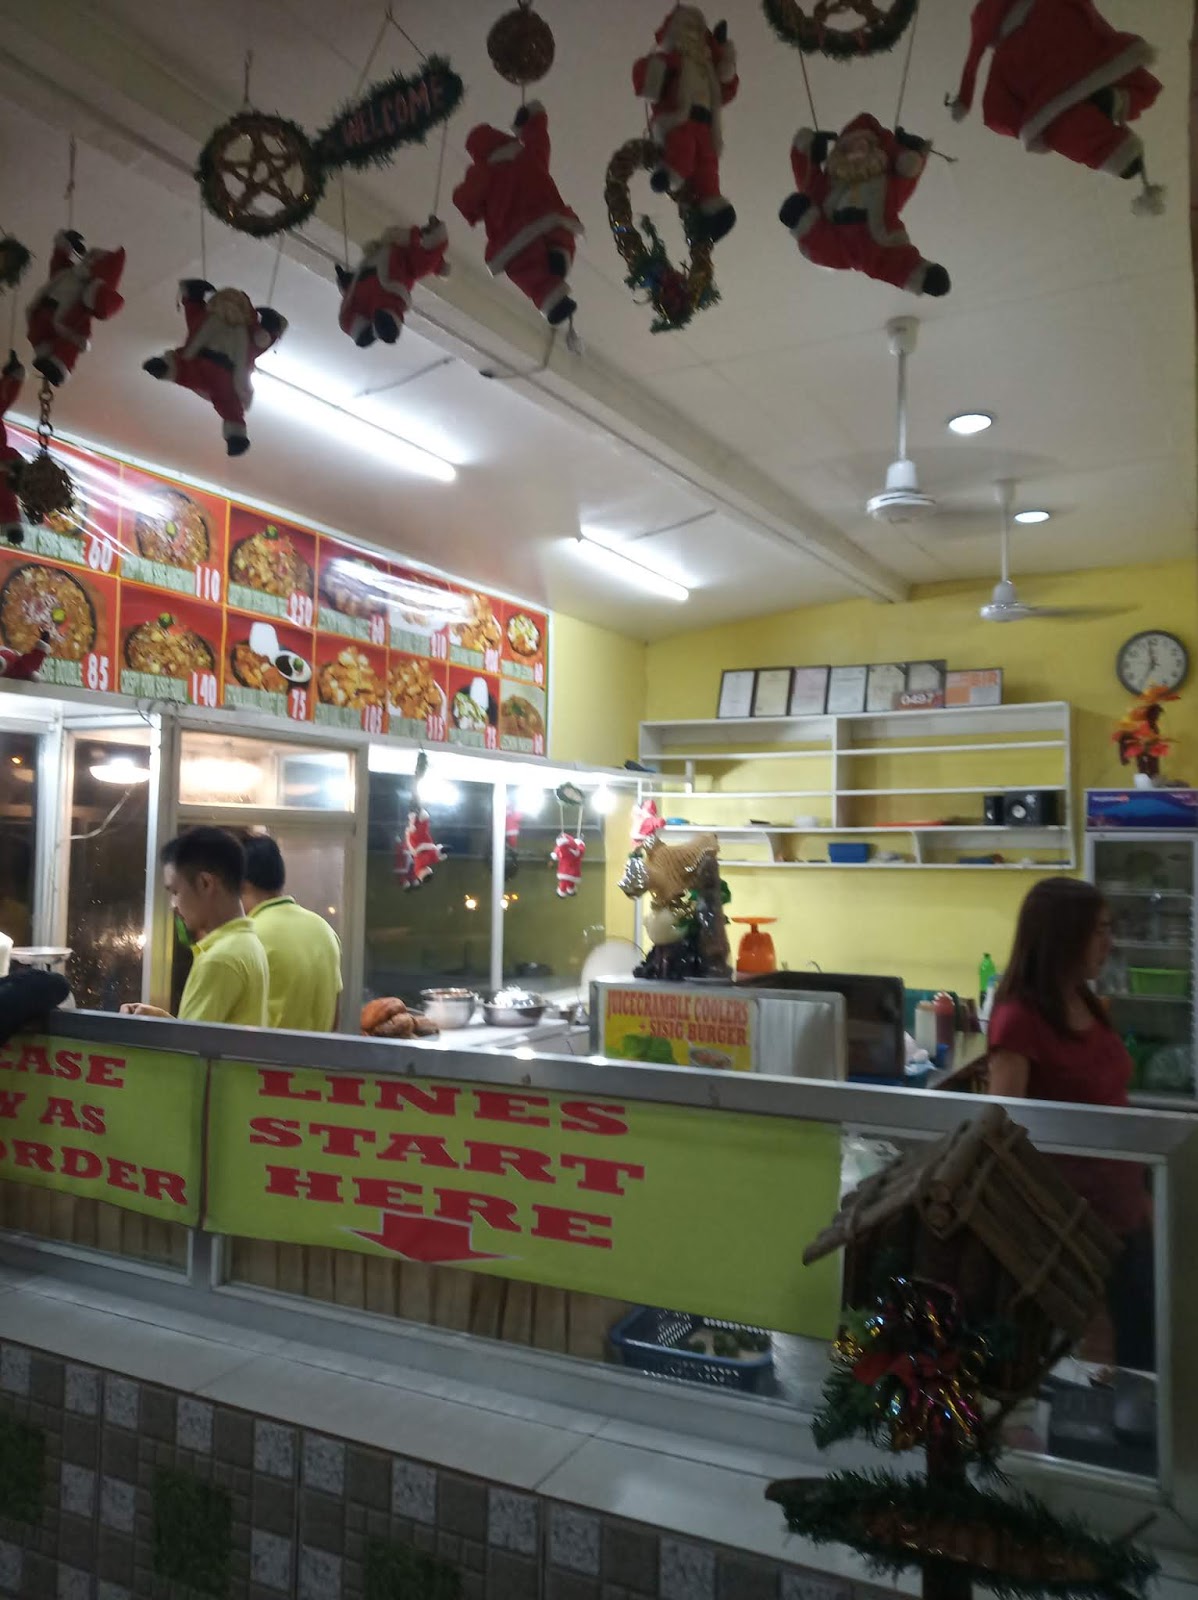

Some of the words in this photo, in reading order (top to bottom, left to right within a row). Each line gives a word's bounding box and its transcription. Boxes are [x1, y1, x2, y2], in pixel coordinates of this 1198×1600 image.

[88, 535, 113, 572] 60
[194, 564, 221, 602] 110
[87, 653, 110, 691] 85
[192, 671, 217, 708] 140
[290, 688, 307, 720] 75
[650, 1020, 684, 1039] SISIG
[688, 1023, 747, 1045] BURGER
[40, 1097, 107, 1136] AS
[257, 1068, 629, 1136] LINES
[0, 1138, 188, 1206] RDER
[249, 1116, 645, 1196] START
[265, 1164, 613, 1249] HERE
